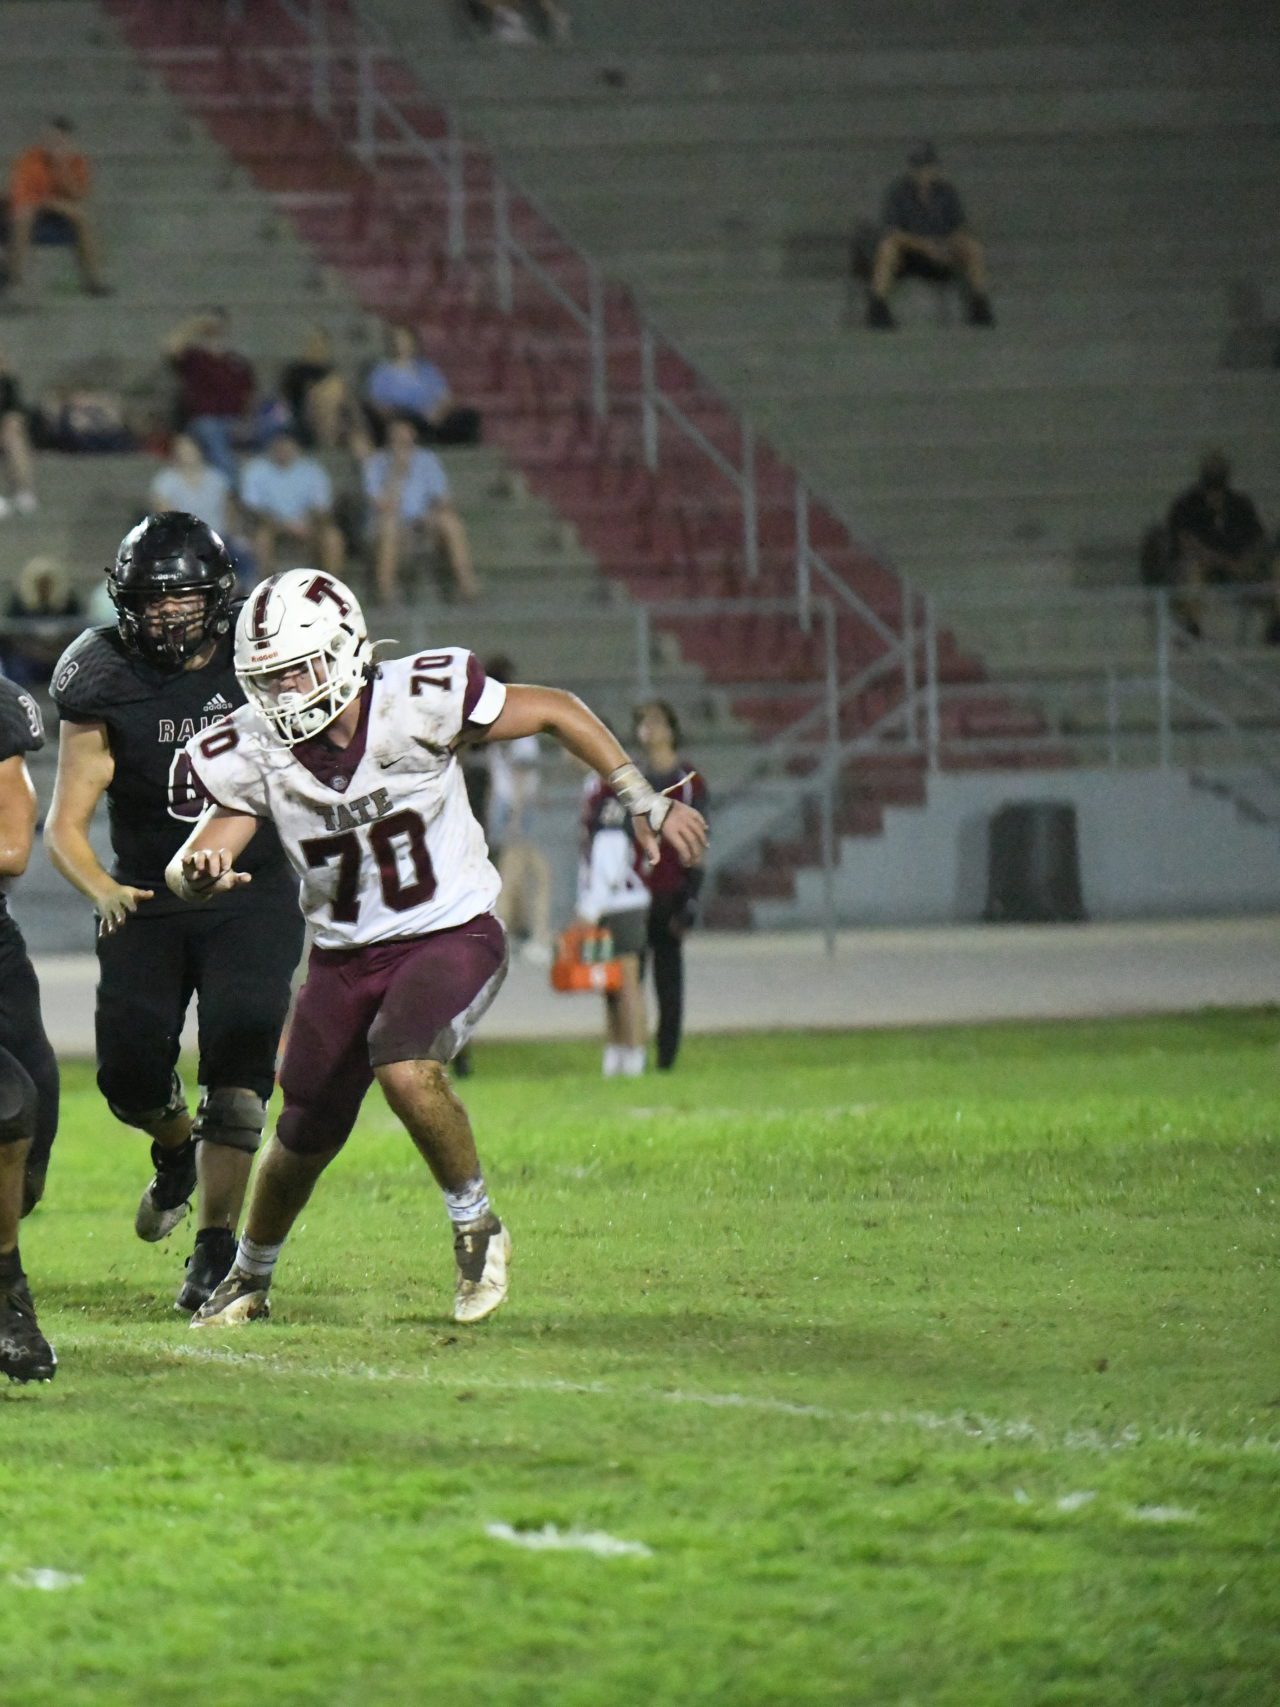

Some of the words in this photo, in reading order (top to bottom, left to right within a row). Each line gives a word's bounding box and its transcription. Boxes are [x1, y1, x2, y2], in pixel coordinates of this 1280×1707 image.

[303, 575, 351, 618] T
[57, 654, 80, 692] 8
[410, 654, 454, 697] 70
[314, 786, 394, 832] TATE
[301, 807, 438, 926] 70
